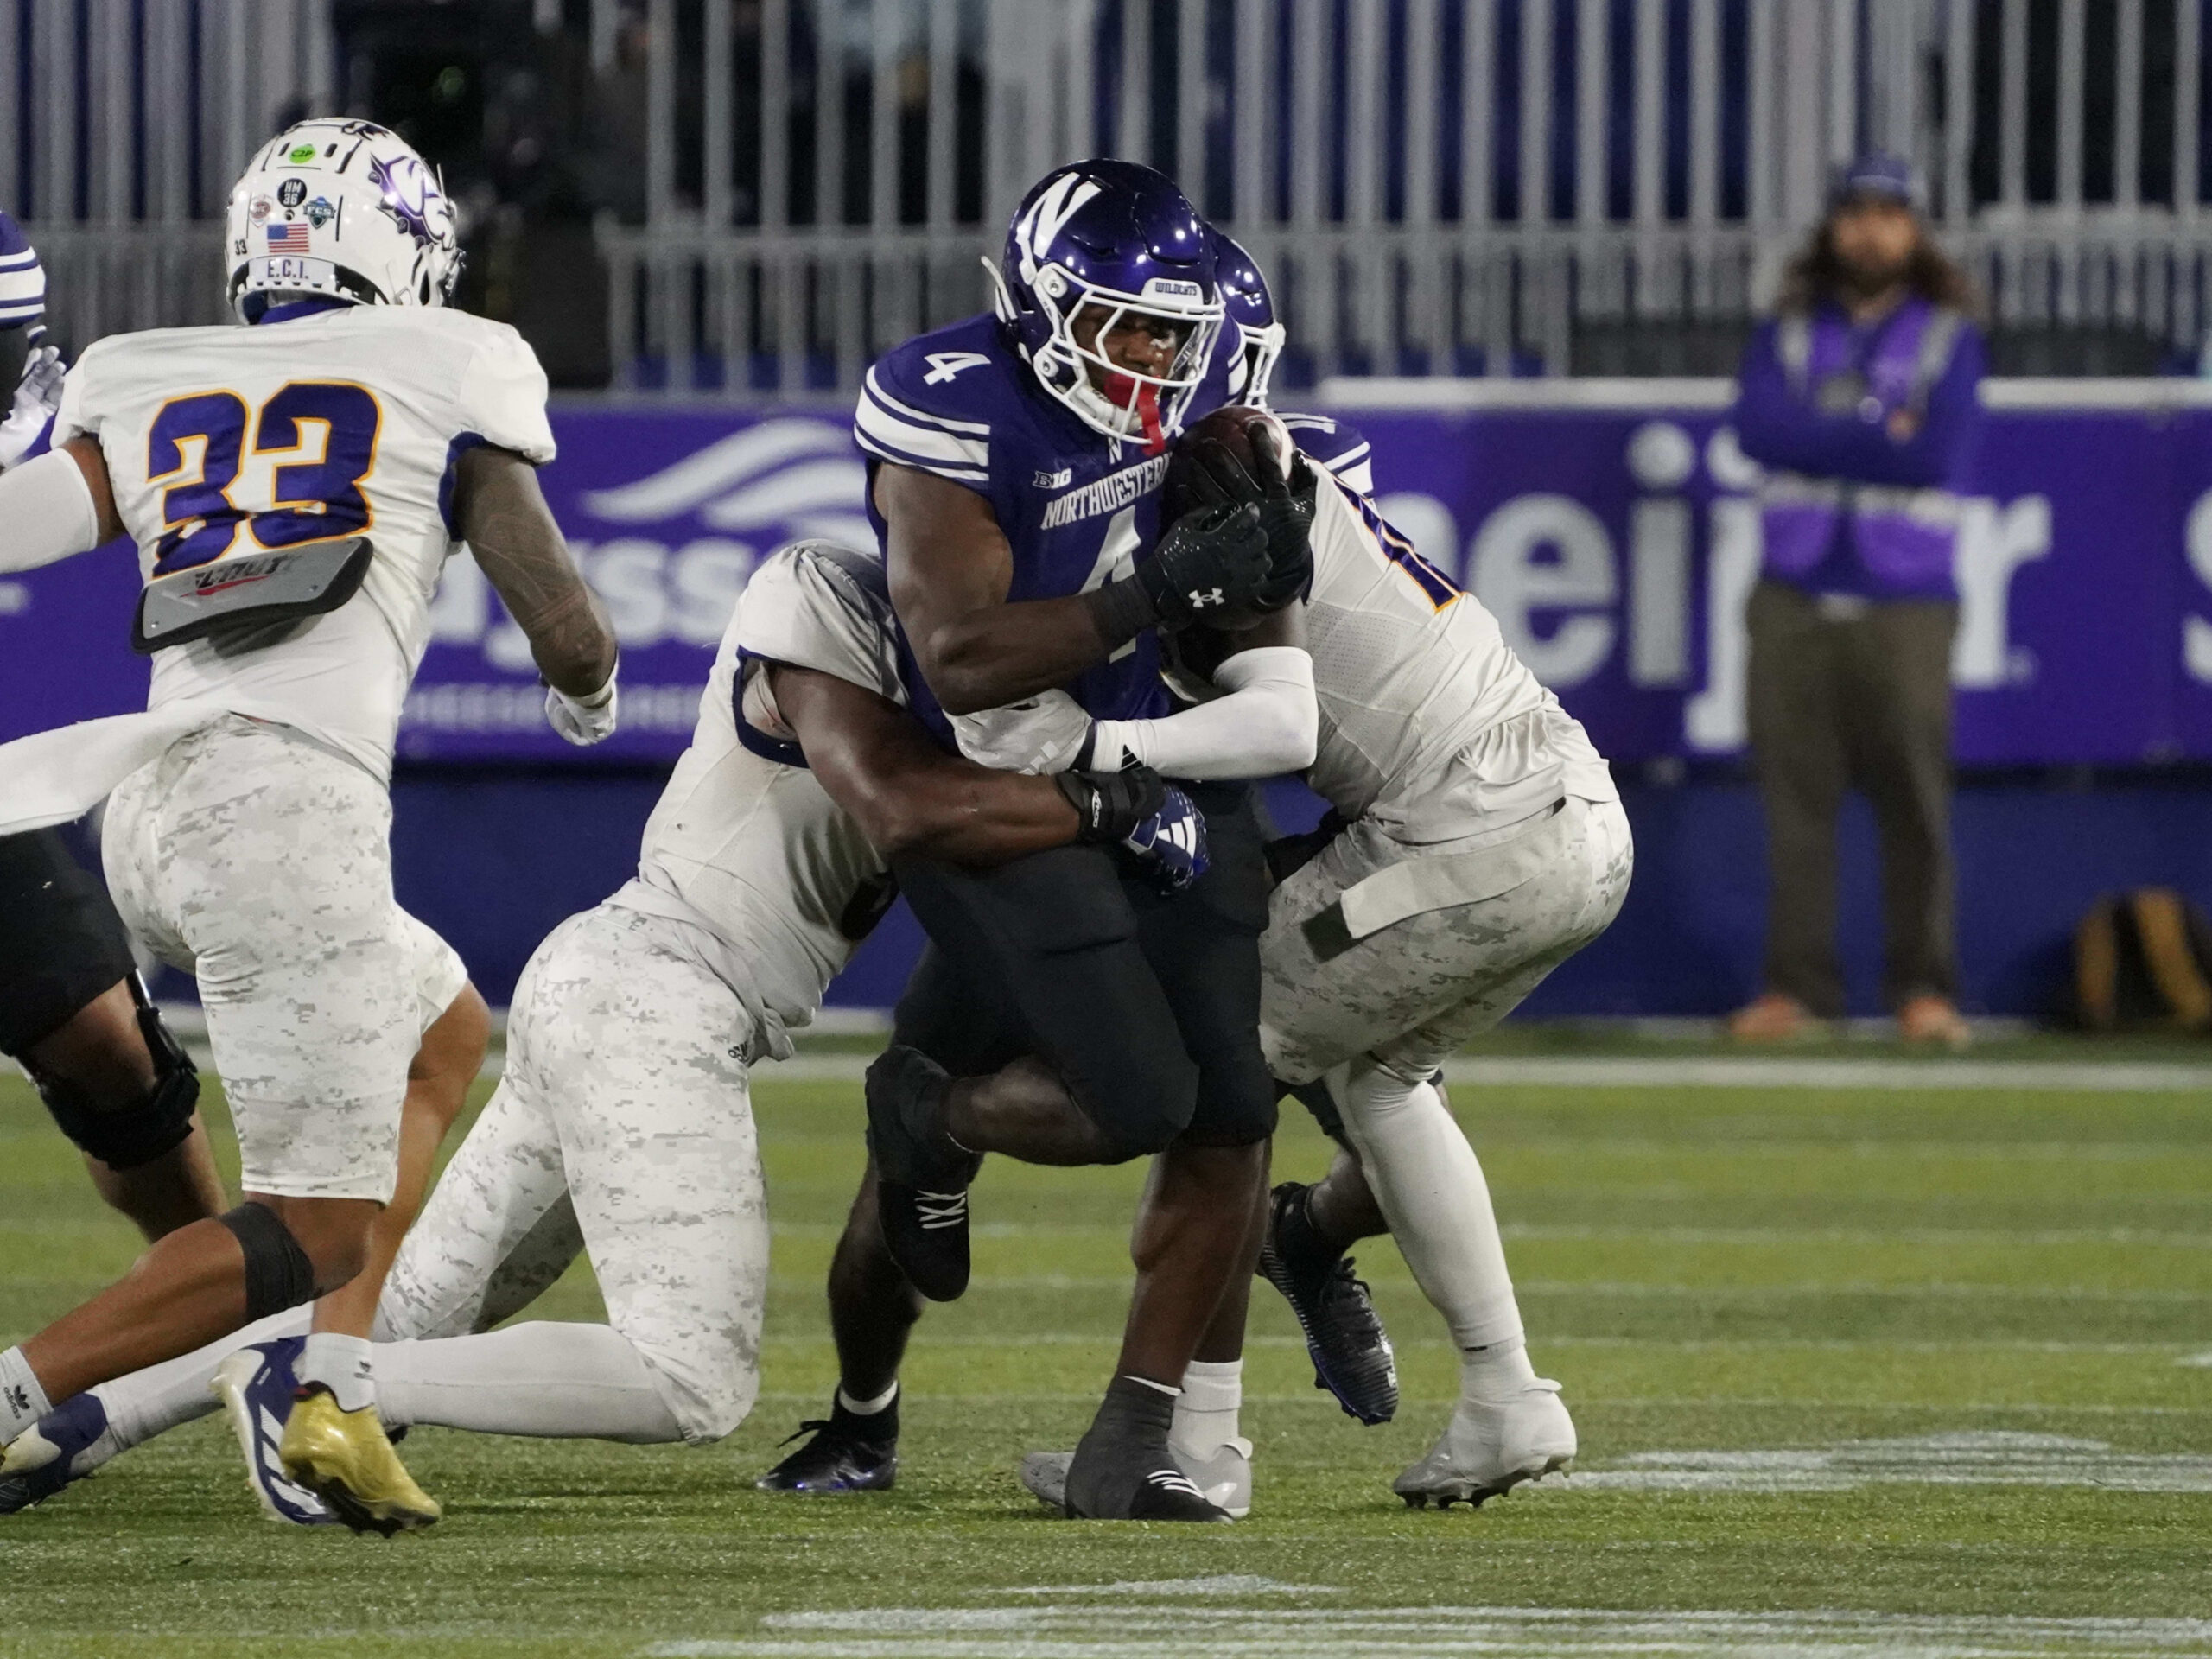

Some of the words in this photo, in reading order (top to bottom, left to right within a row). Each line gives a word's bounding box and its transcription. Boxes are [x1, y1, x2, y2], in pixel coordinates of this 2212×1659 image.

[284, 181, 302, 194] HM
[283, 192, 298, 206] 36
[235, 239, 247, 255] 33
[1154, 282, 1198, 296] WILDCATS
[922, 351, 992, 386] 4
[145, 378, 384, 582] 33
